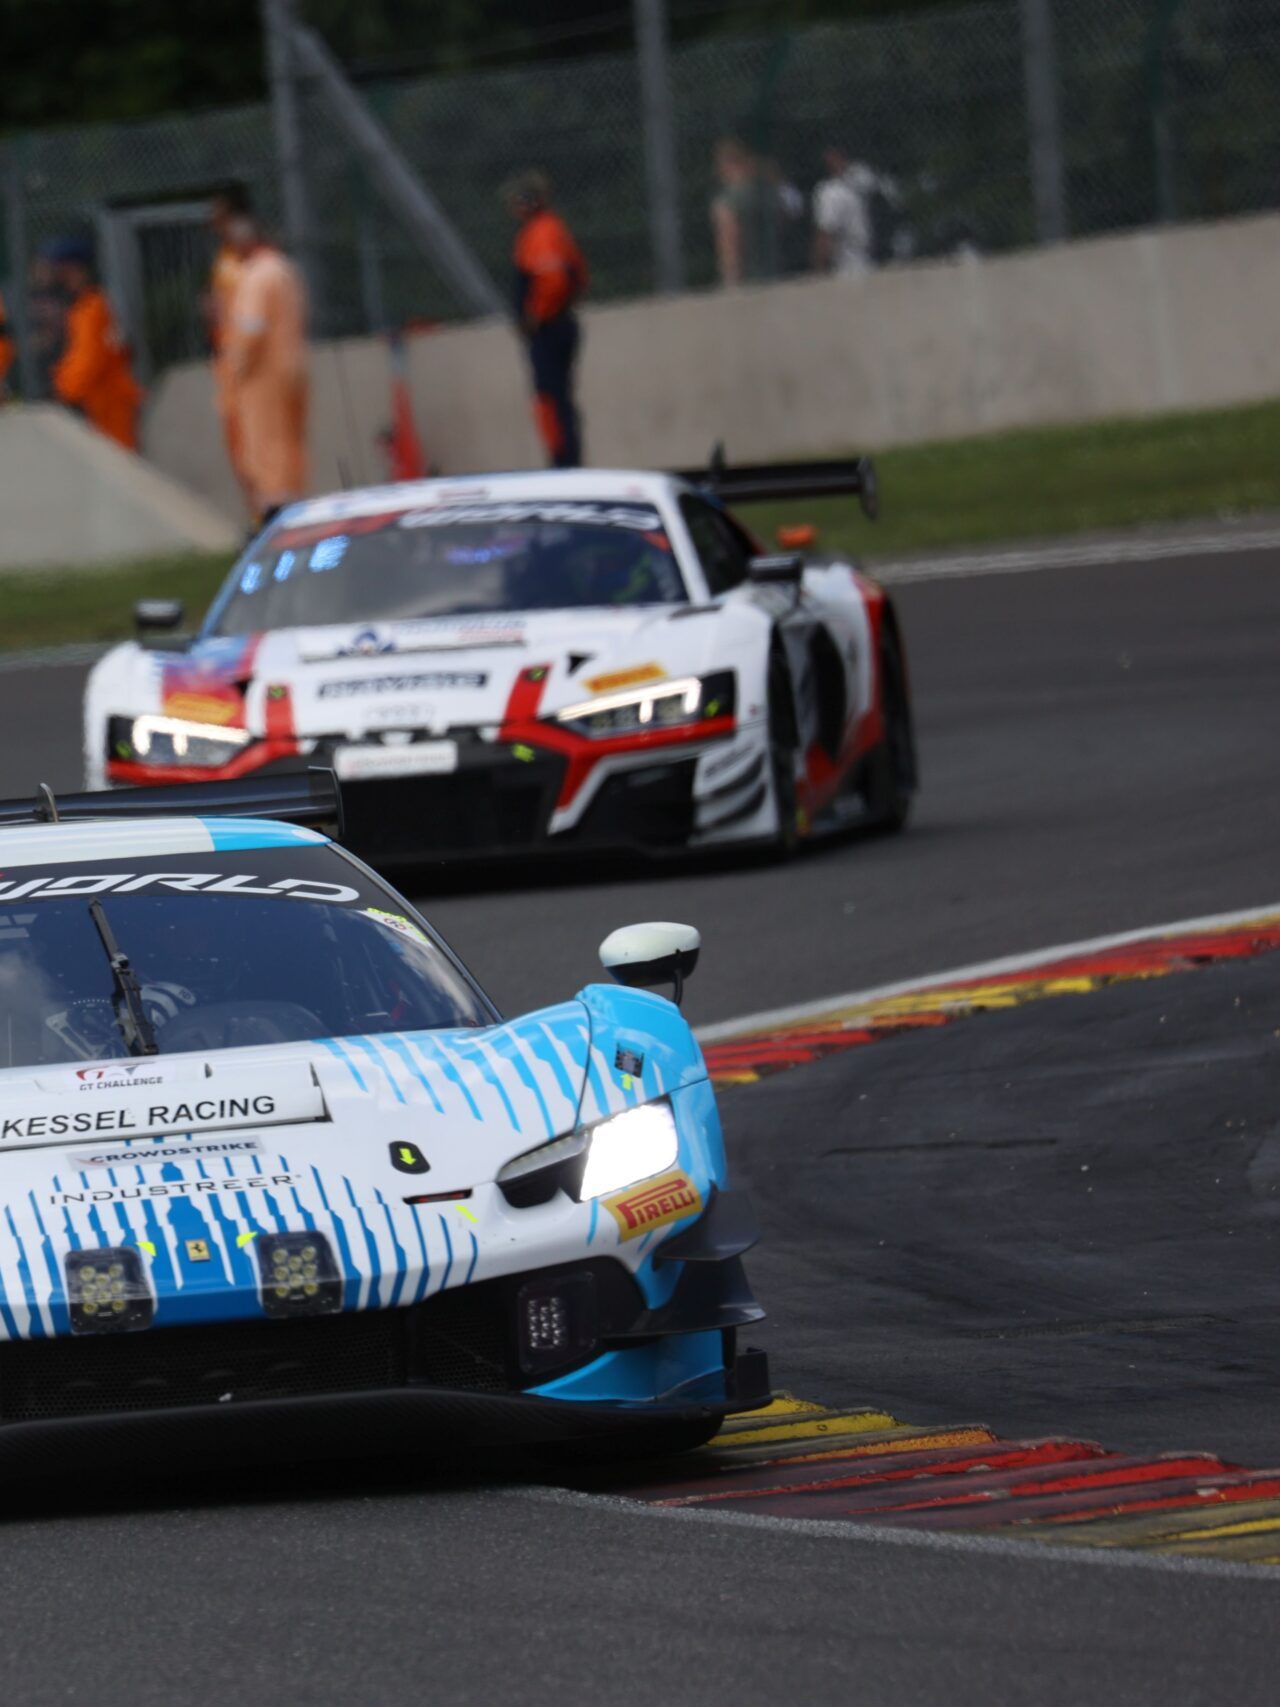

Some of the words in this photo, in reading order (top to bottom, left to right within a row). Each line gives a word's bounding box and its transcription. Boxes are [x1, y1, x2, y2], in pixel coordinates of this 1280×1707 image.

[79, 1083, 94, 1091] GT
[96, 1076, 163, 1090] CHALLENGE
[1, 1110, 135, 1139] KESSEL
[148, 1095, 275, 1127] RACING
[89, 1141, 258, 1164] CROWDSTRIKE
[50, 1174, 296, 1206] INDUSTREER
[616, 1178, 697, 1230] PIRELLI
